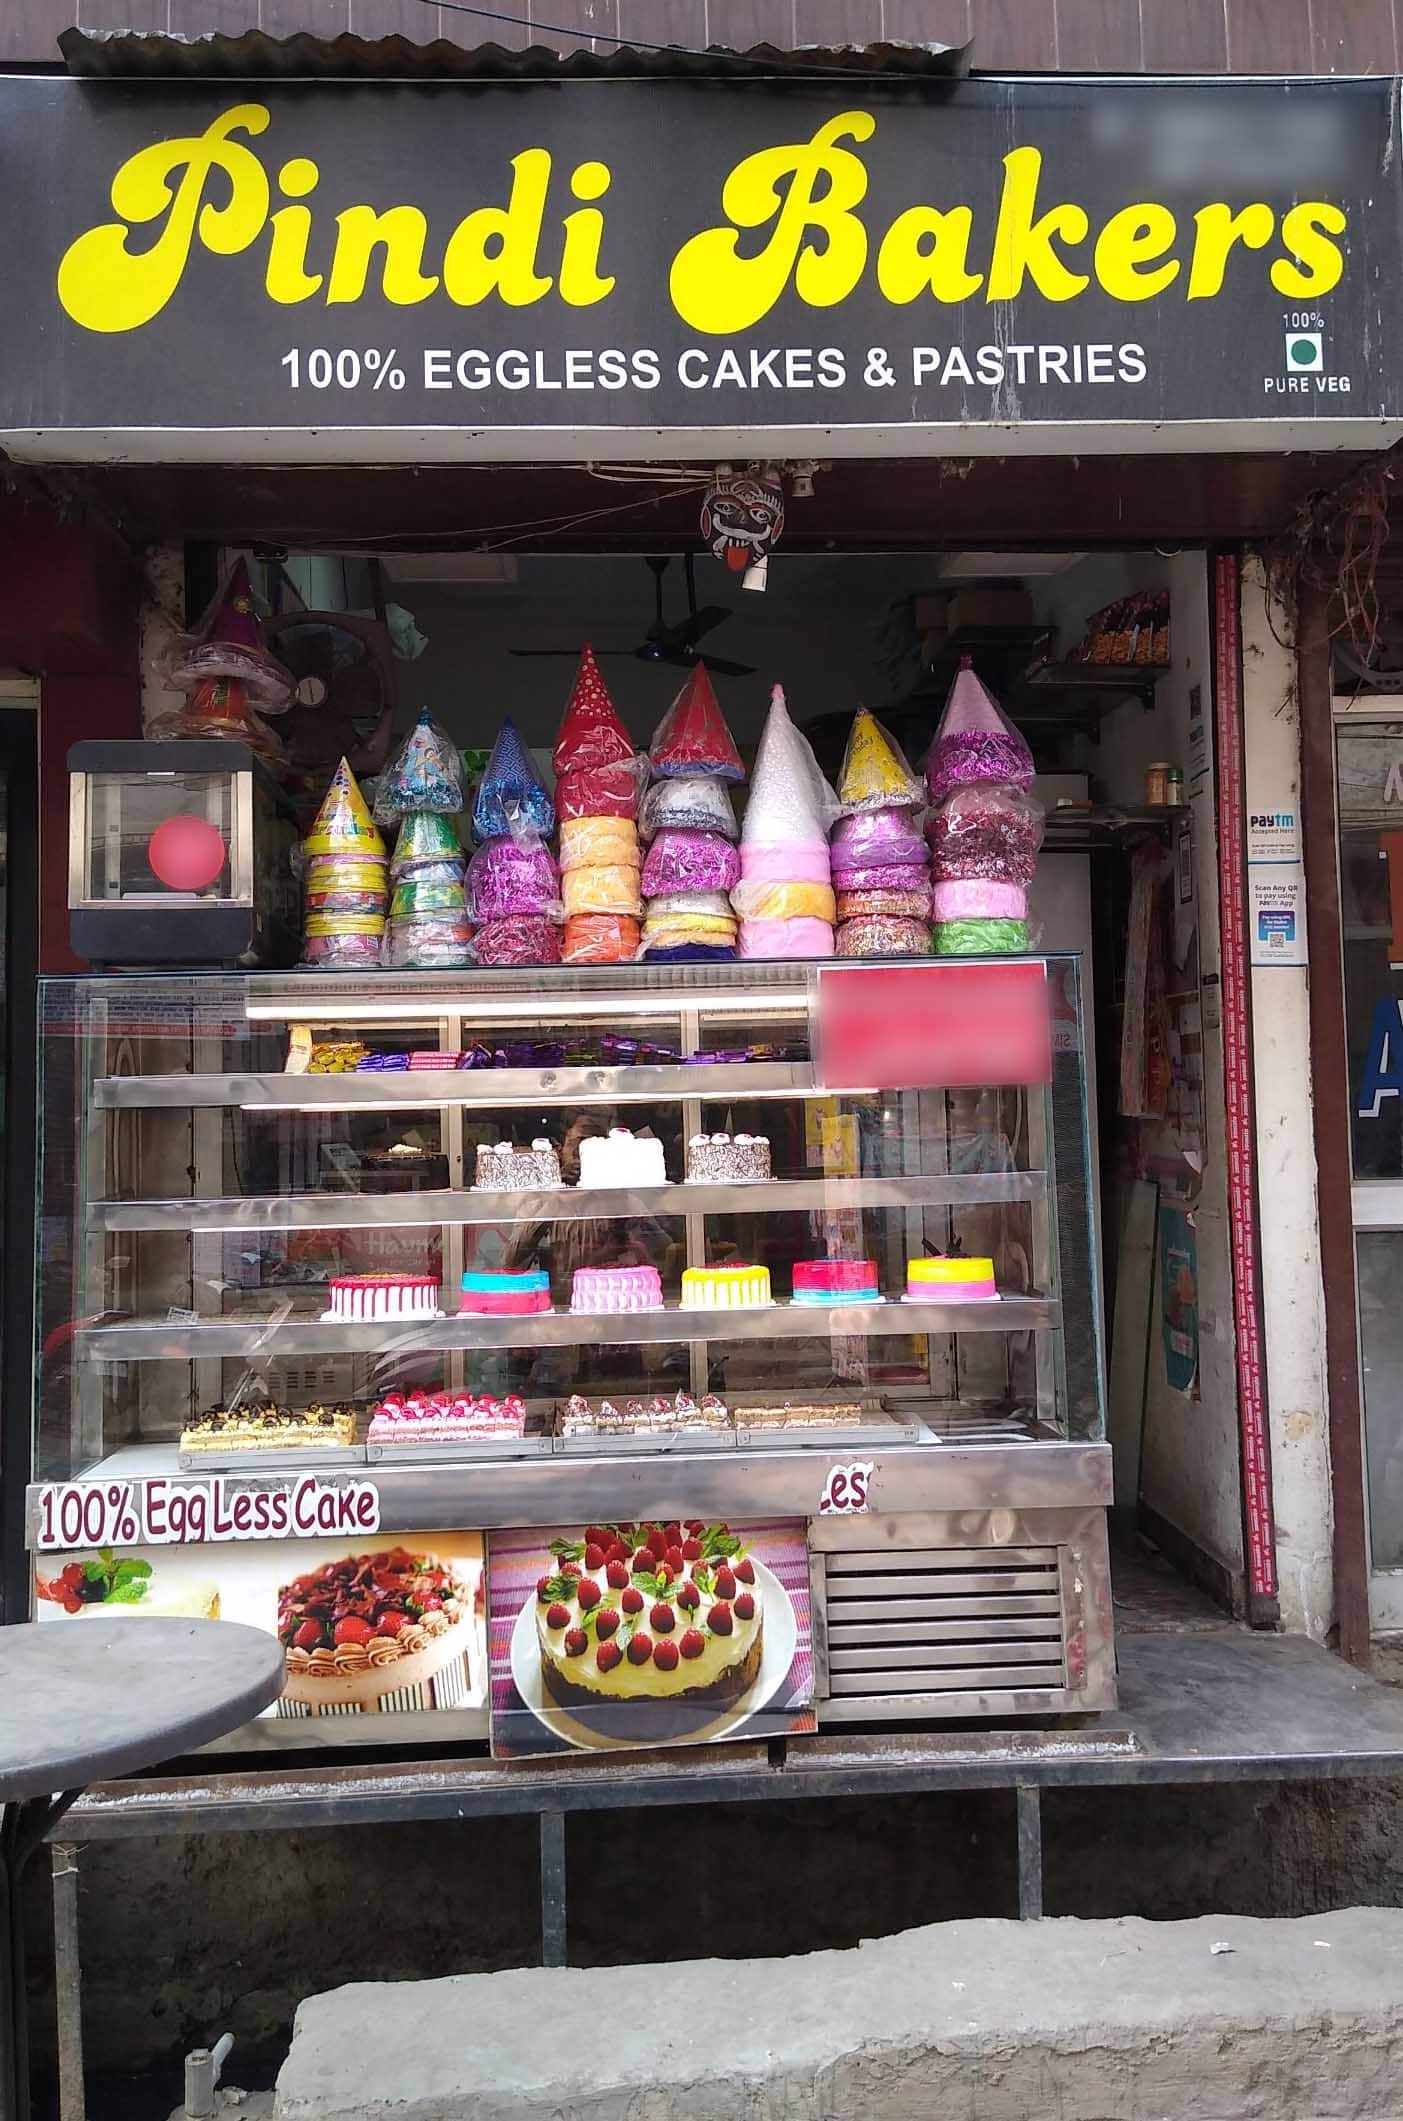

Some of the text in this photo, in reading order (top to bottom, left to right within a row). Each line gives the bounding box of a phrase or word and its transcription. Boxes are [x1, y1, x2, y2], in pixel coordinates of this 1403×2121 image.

[57, 103, 1347, 335] Pindi Bakers
[1283, 312, 1326, 328] 100%
[281, 340, 1148, 391] 100% EGGLESS CAKES & PASTRIES
[1264, 376, 1351, 393] PURE VEG
[1272, 884, 1287, 893] Any
[1277, 892, 1296, 900] using
[820, 1471, 866, 1509] es
[42, 1486, 135, 1543] 100%
[294, 1478, 377, 1531] Cake
